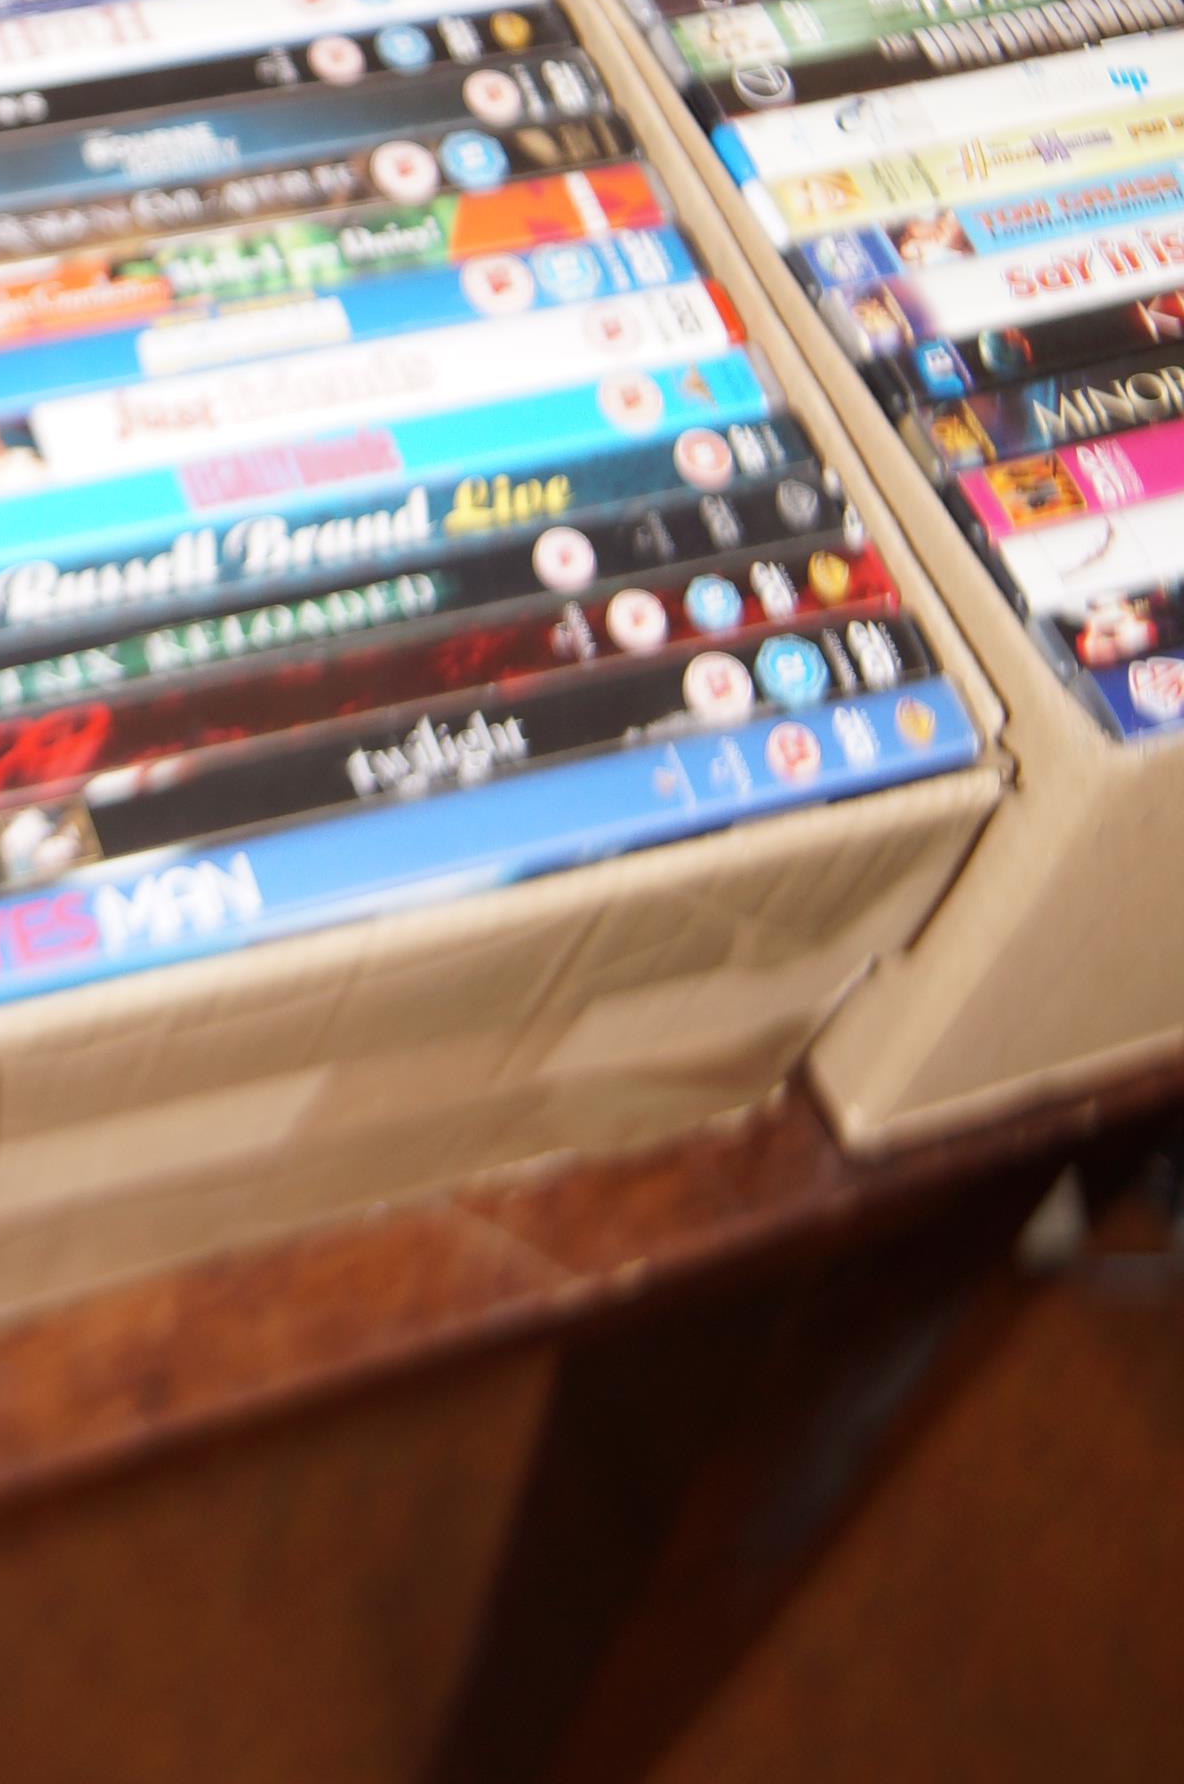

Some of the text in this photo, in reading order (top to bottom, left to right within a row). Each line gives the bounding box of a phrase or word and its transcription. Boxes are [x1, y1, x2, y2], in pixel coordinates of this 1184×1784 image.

[220, 484, 432, 568] Brand
[442, 470, 572, 538] Live
[140, 570, 440, 674] RELOADED
[344, 706, 532, 804] twilight
[90, 850, 266, 960] MAN
